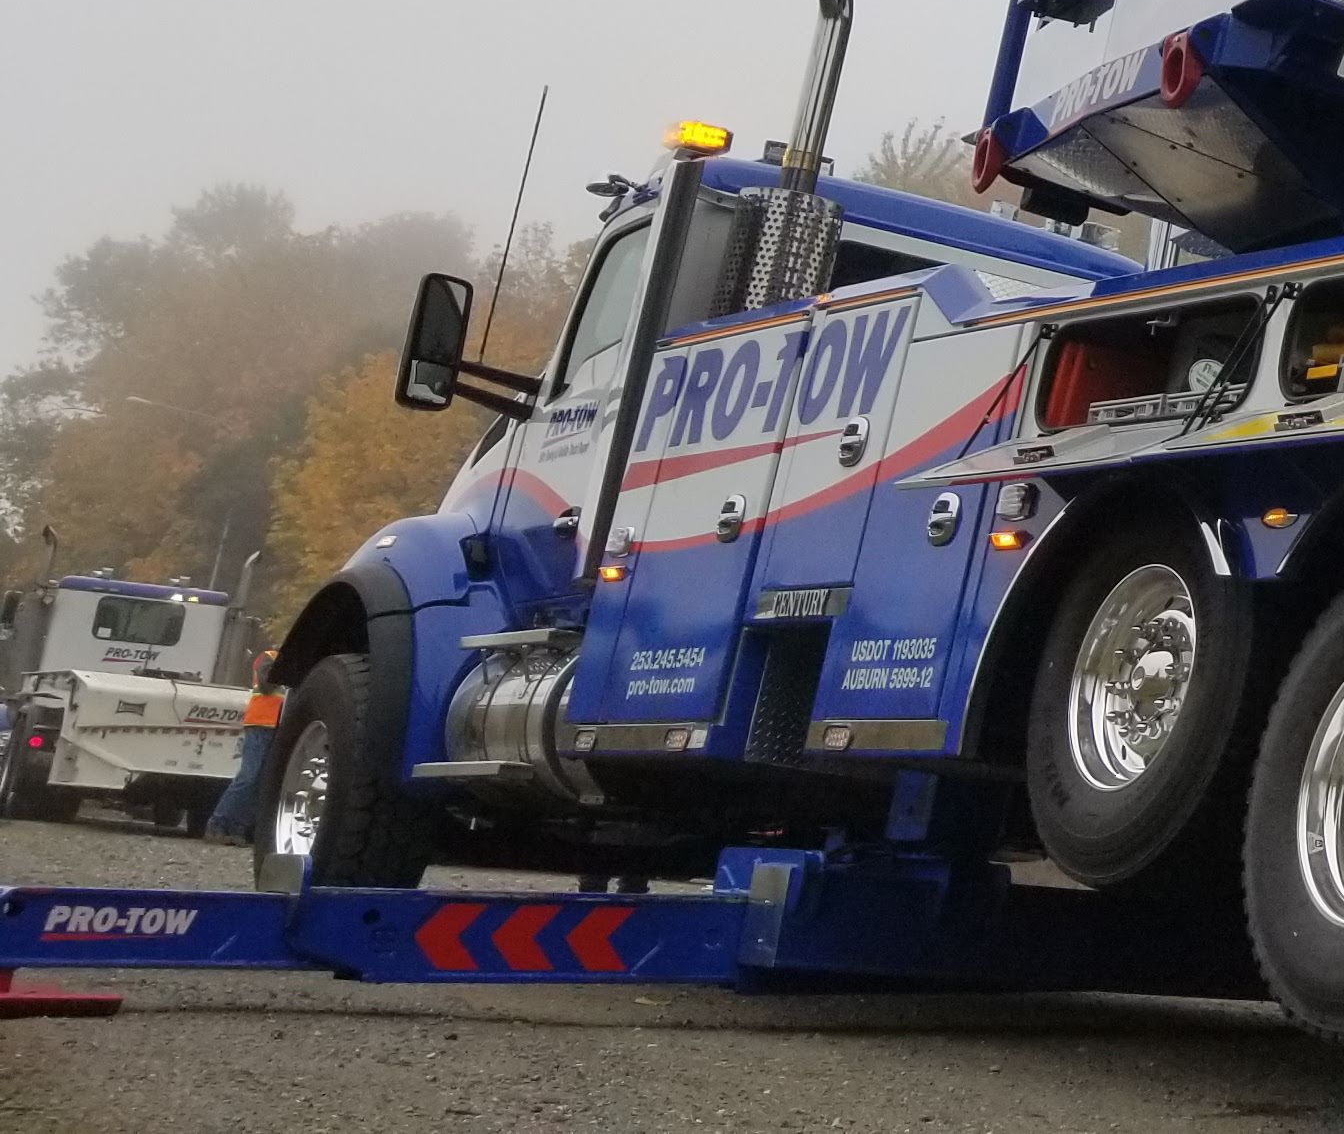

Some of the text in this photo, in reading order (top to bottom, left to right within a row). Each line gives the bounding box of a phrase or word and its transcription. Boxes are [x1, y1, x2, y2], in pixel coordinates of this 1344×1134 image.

[1049, 47, 1148, 128] PRO-TOW
[634, 306, 912, 452] PRO-TOW
[773, 588, 829, 617] CENTURY
[105, 646, 161, 661] PRO-TOW
[630, 647, 706, 670] 253.245.5454
[851, 637, 937, 662] USDOT 1193035
[625, 676, 696, 700] pro-tow.com
[841, 666, 934, 690] AUBURN 5899-12
[44, 905, 199, 935] PRO-TOW
